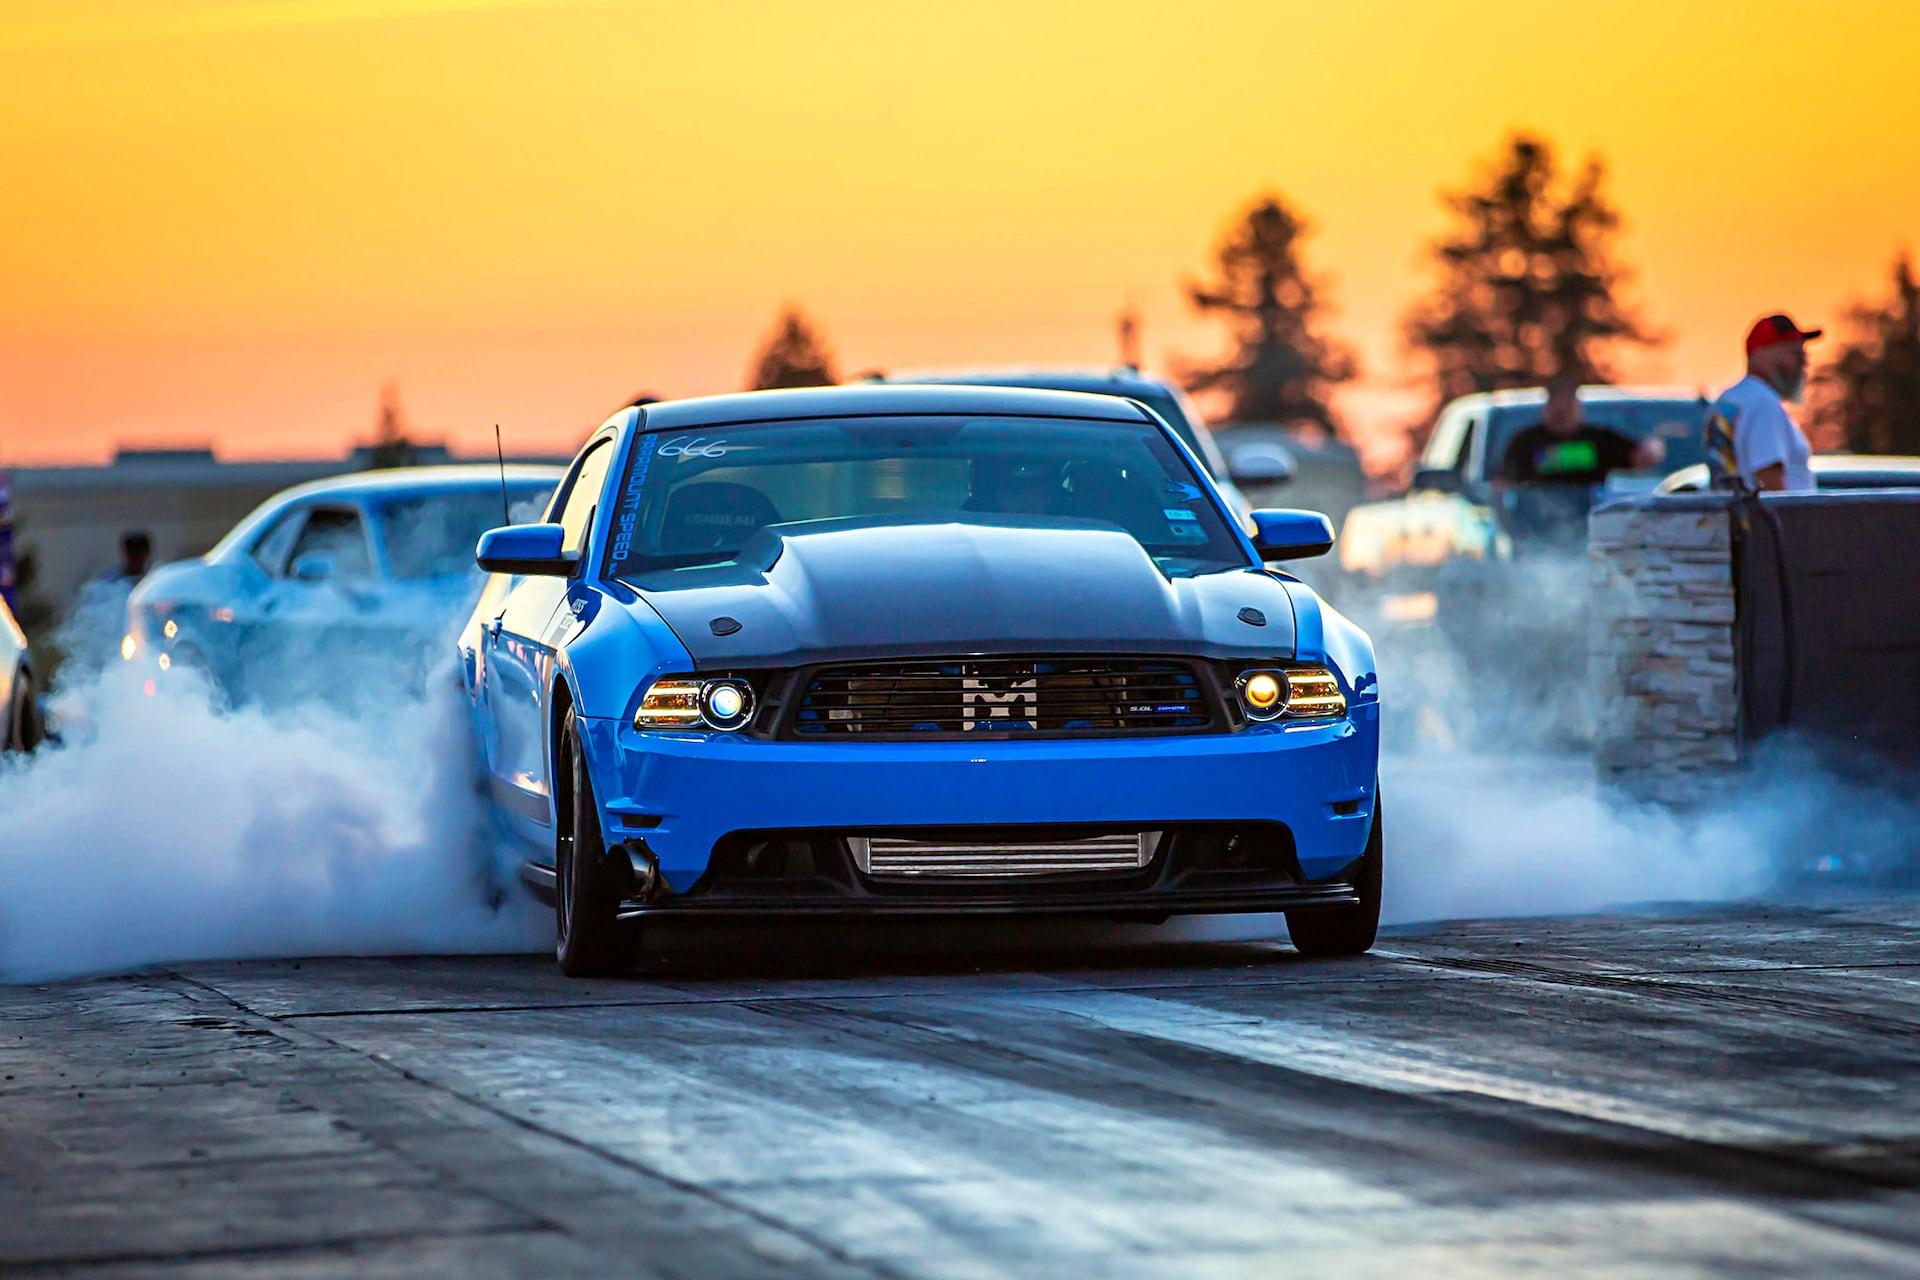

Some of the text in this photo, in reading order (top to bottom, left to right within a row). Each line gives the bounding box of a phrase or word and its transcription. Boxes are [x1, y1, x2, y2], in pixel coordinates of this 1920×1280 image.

[657, 435, 727, 458] 666
[612, 433, 658, 561] PARAMOUNT SPEED
